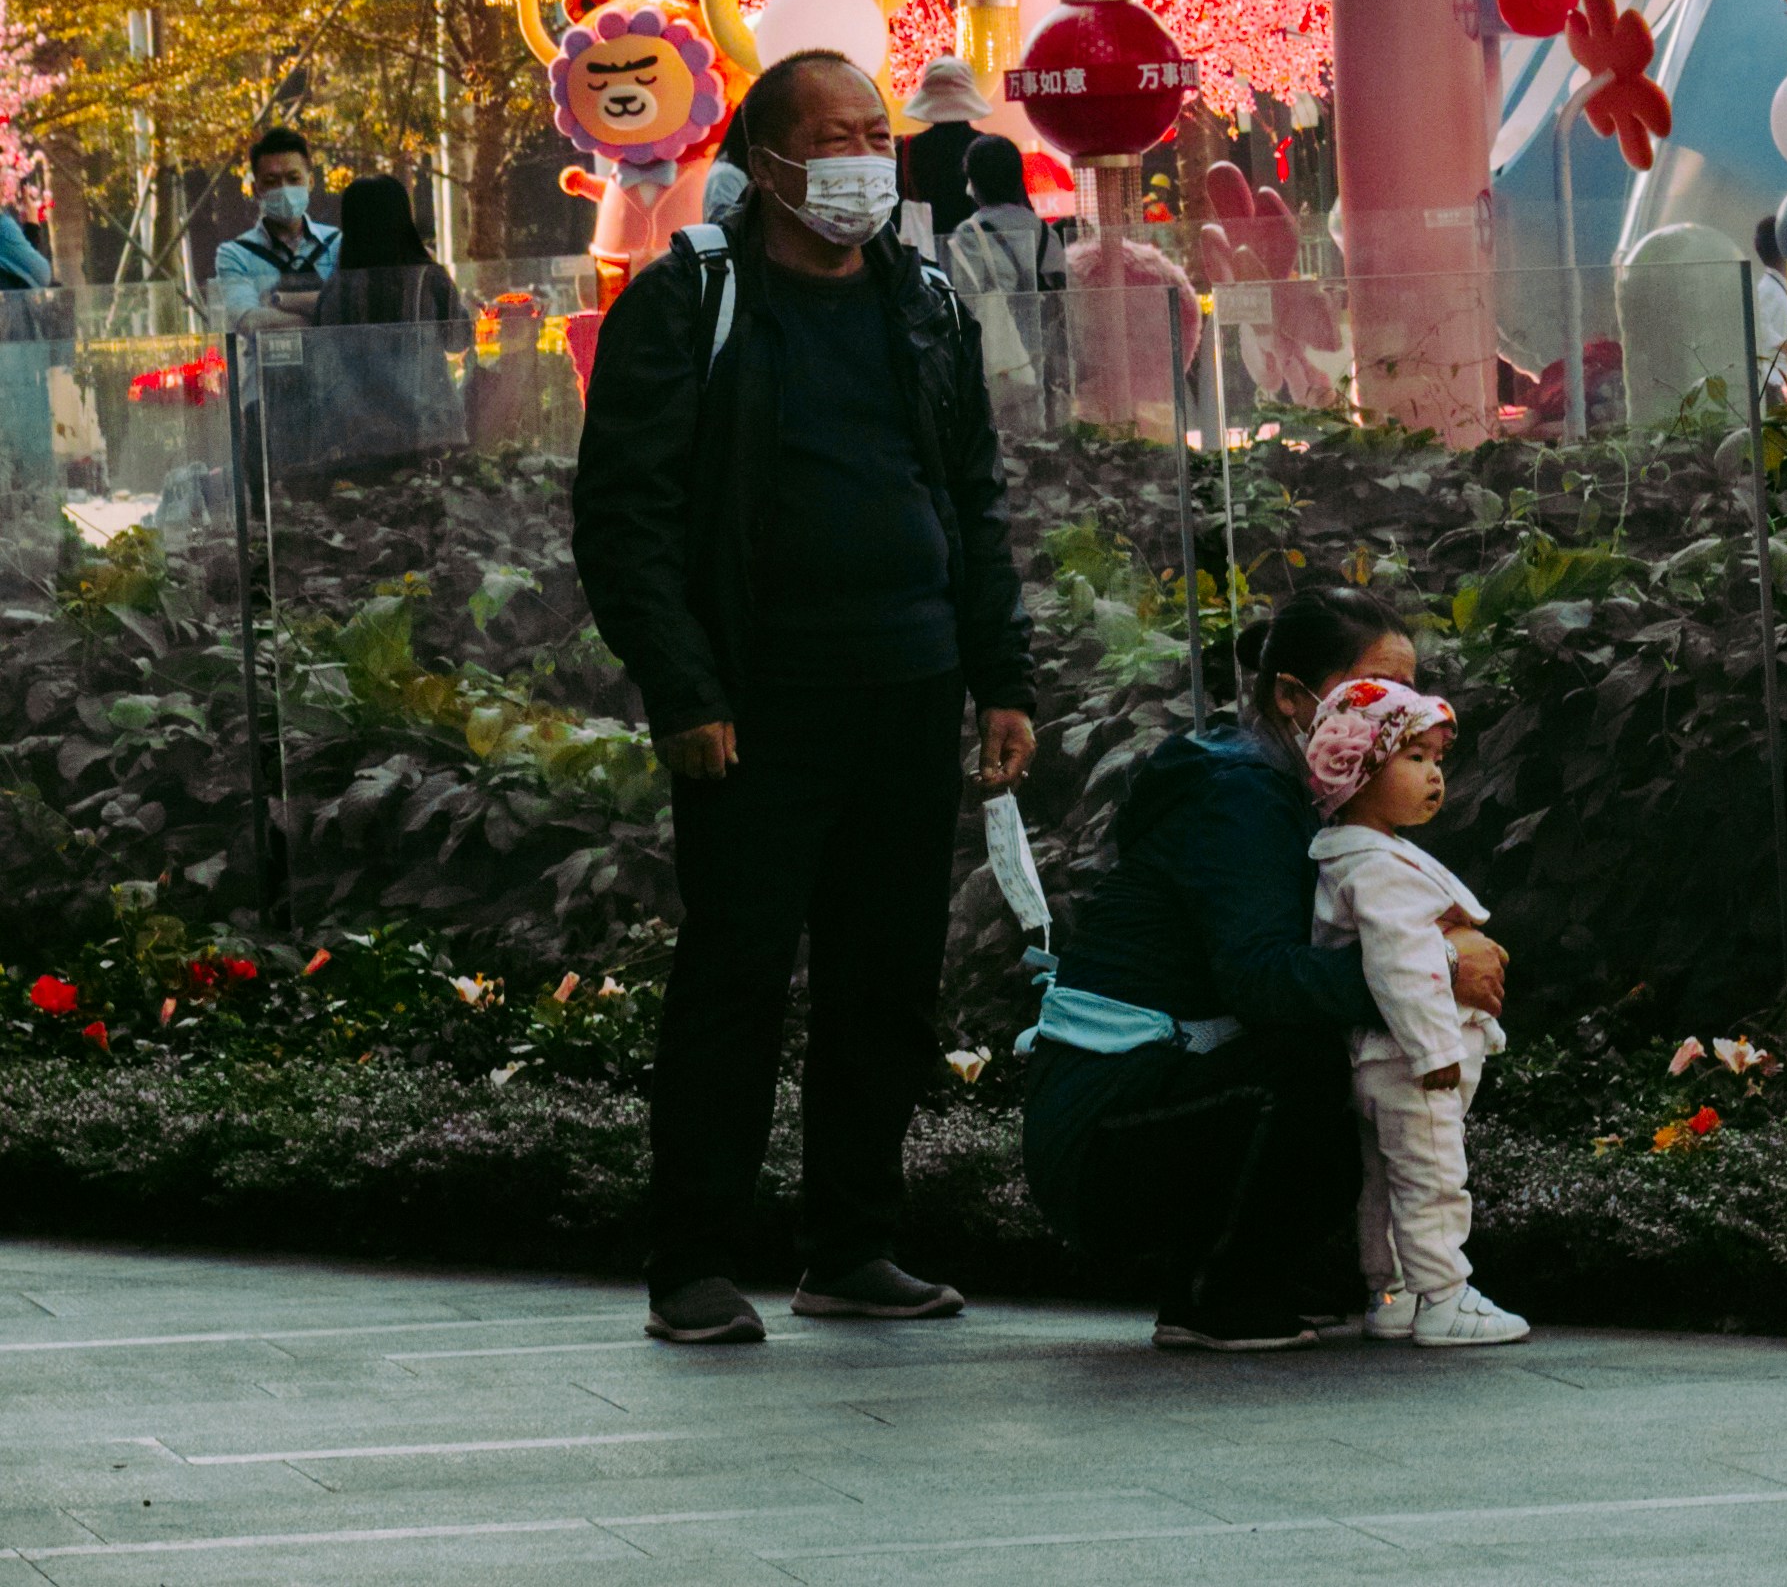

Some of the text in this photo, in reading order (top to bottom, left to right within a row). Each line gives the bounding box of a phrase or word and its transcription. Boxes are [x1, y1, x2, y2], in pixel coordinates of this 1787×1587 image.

[1008, 61, 1199, 98] 万事如意 万事如
